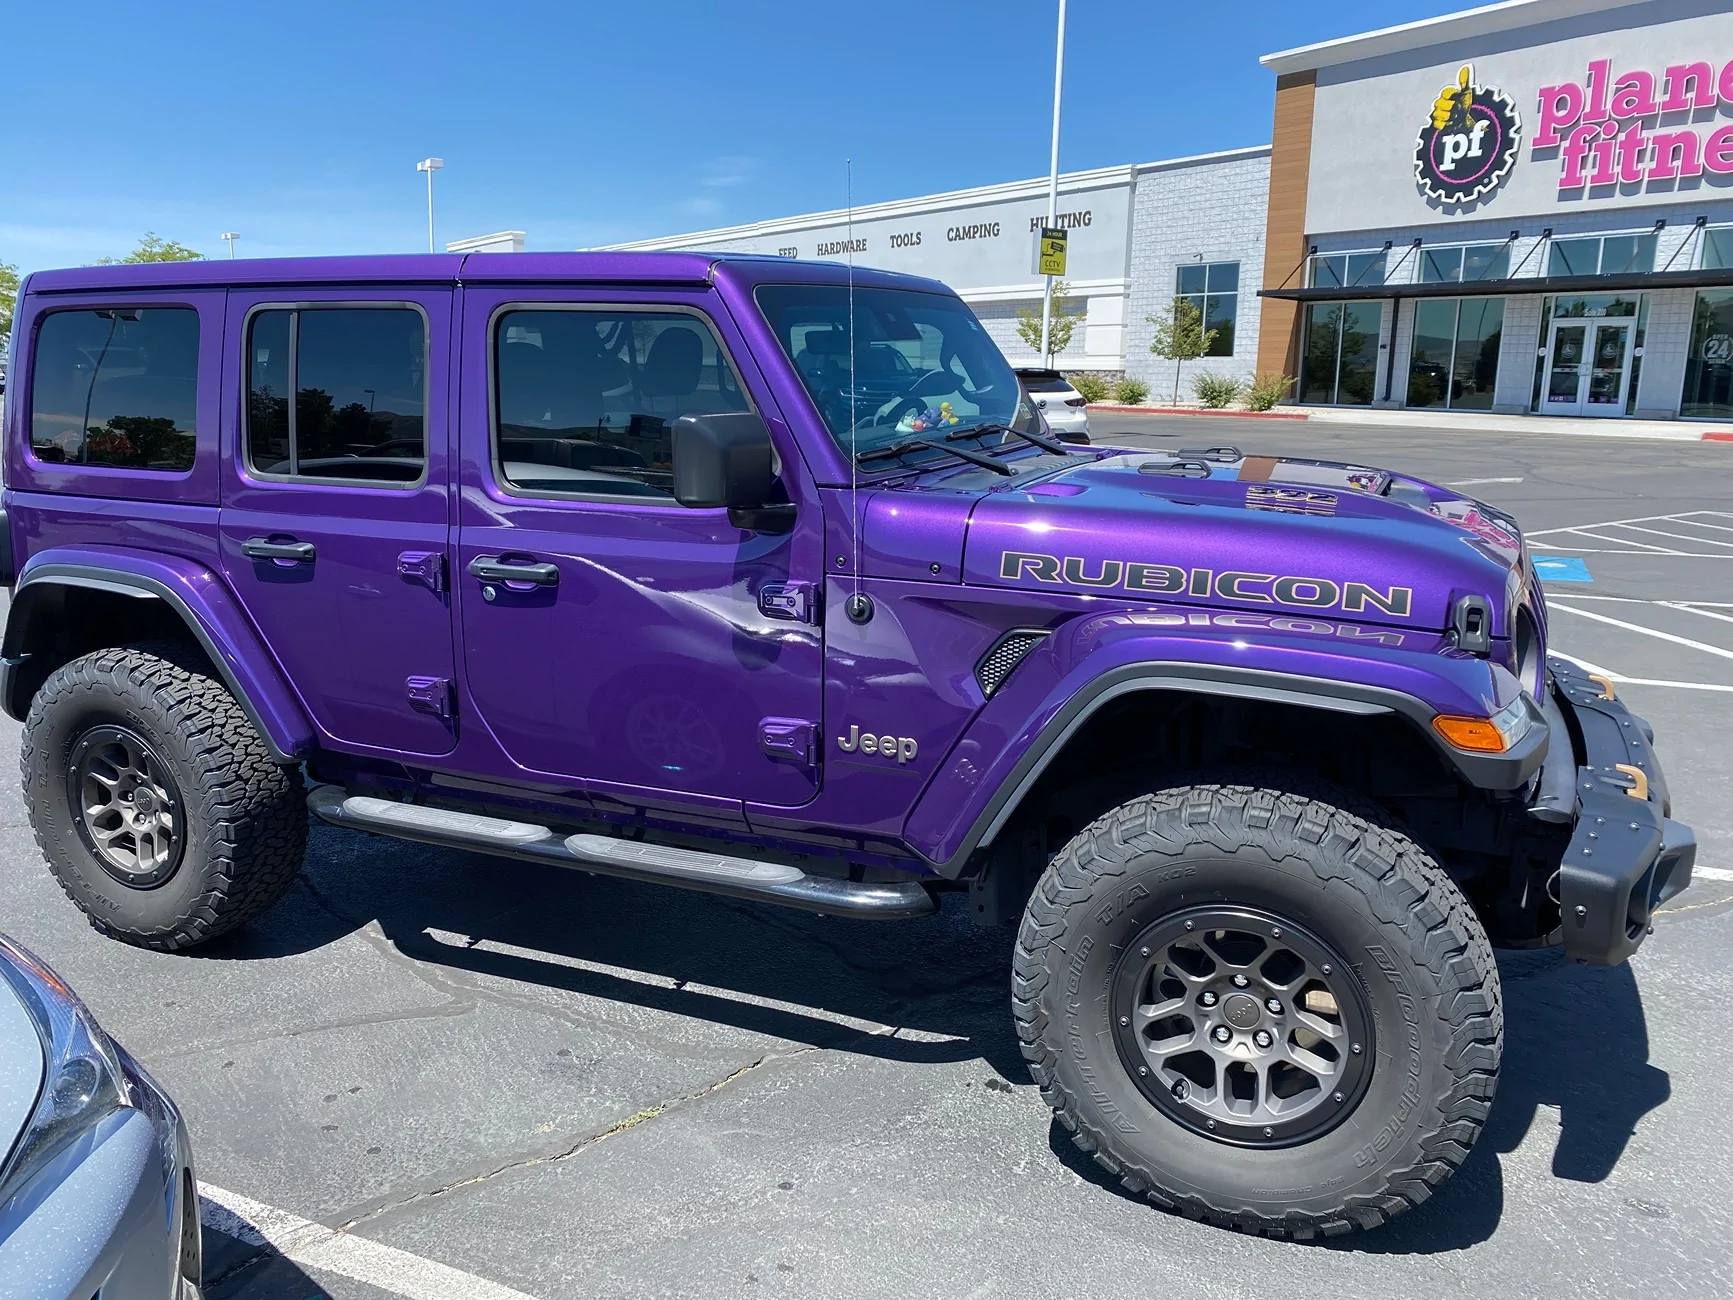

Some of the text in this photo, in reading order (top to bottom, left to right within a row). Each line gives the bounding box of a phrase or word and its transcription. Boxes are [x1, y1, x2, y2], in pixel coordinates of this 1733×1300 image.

[1439, 119, 1491, 171] pf
[1557, 120, 1733, 189] fitne
[817, 238, 868, 256] HARDWARE
[889, 231, 922, 248] TOOLS
[946, 221, 1000, 242] CAMPING
[1045, 259, 1061, 267] CCTV
[1707, 340, 1729, 358] 24
[1000, 550, 1413, 617] RUBICON
[837, 724, 919, 764] Jeep
[1094, 882, 1150, 926] T/A
[1157, 866, 1197, 884] KO2
[1352, 945, 1422, 1169] BFGoodrich
[1251, 1185, 1313, 1196] Champion
